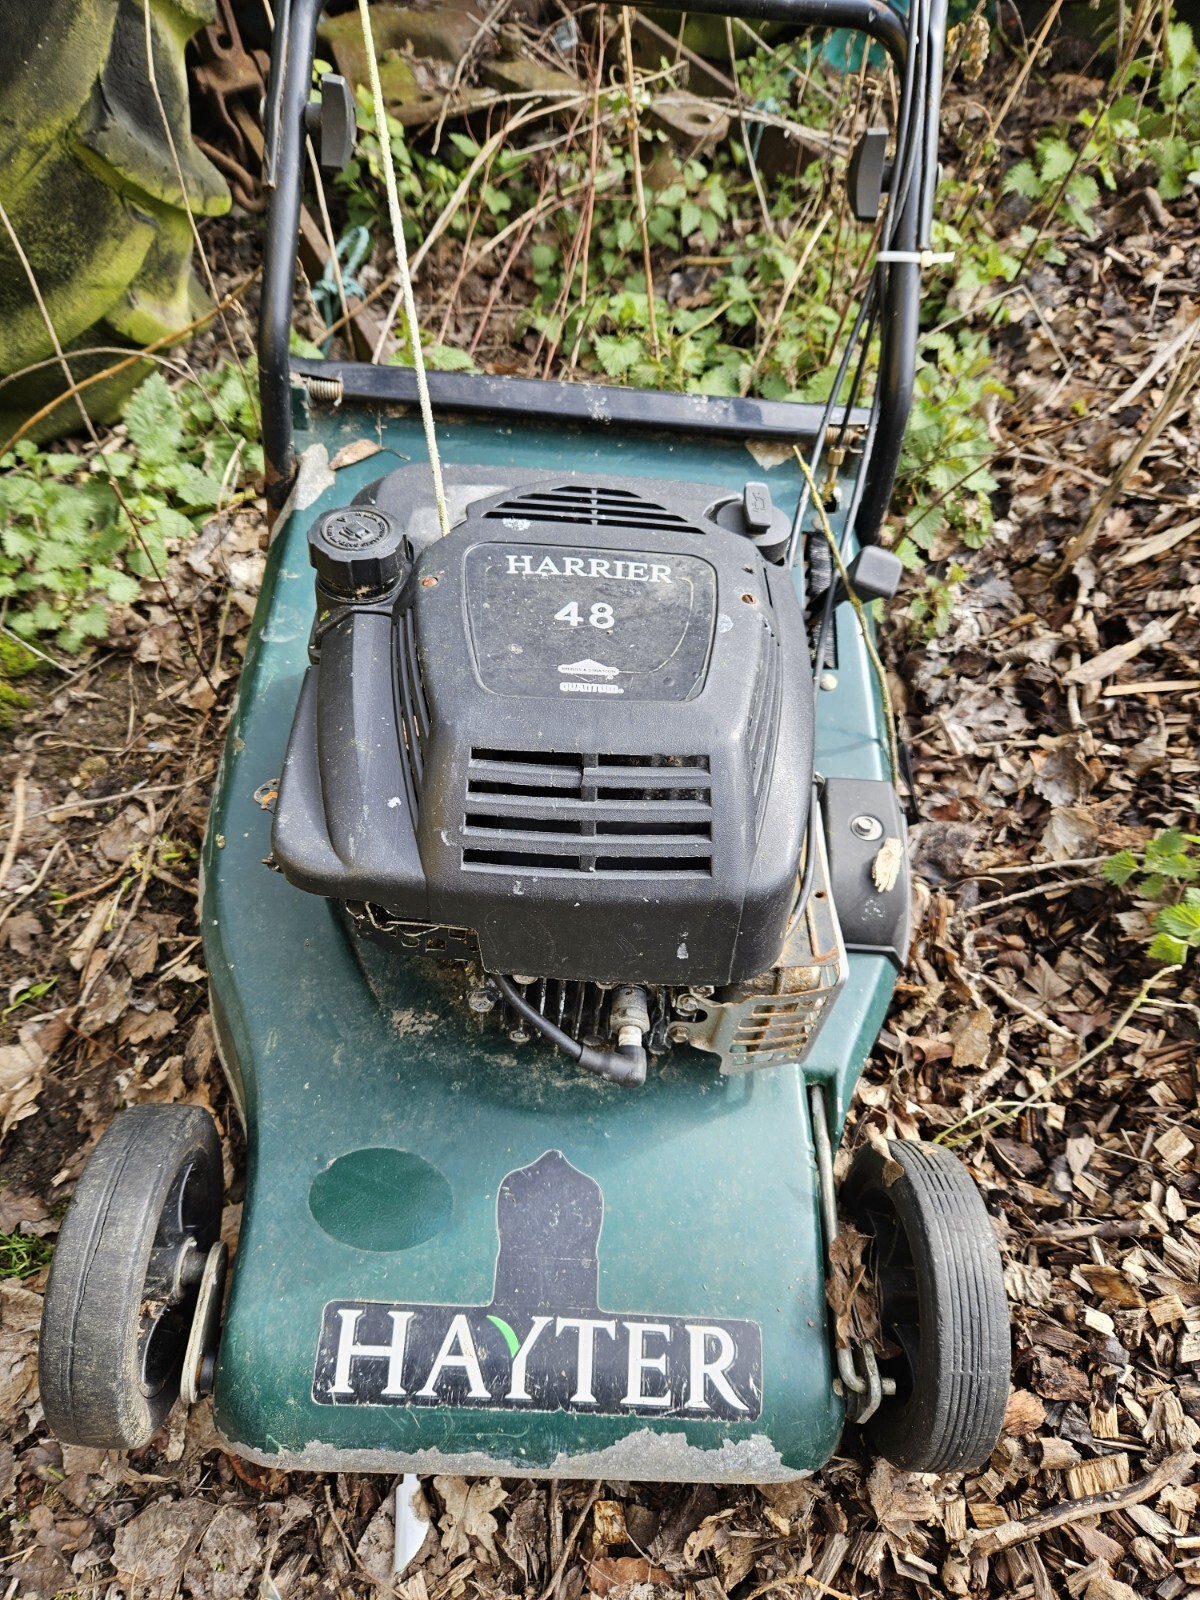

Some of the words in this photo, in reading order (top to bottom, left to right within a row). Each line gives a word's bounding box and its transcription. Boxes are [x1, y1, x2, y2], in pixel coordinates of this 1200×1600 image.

[506, 555, 673, 584] HARRIER
[554, 601, 615, 629] 48
[328, 1309, 750, 1411] HAYTER
